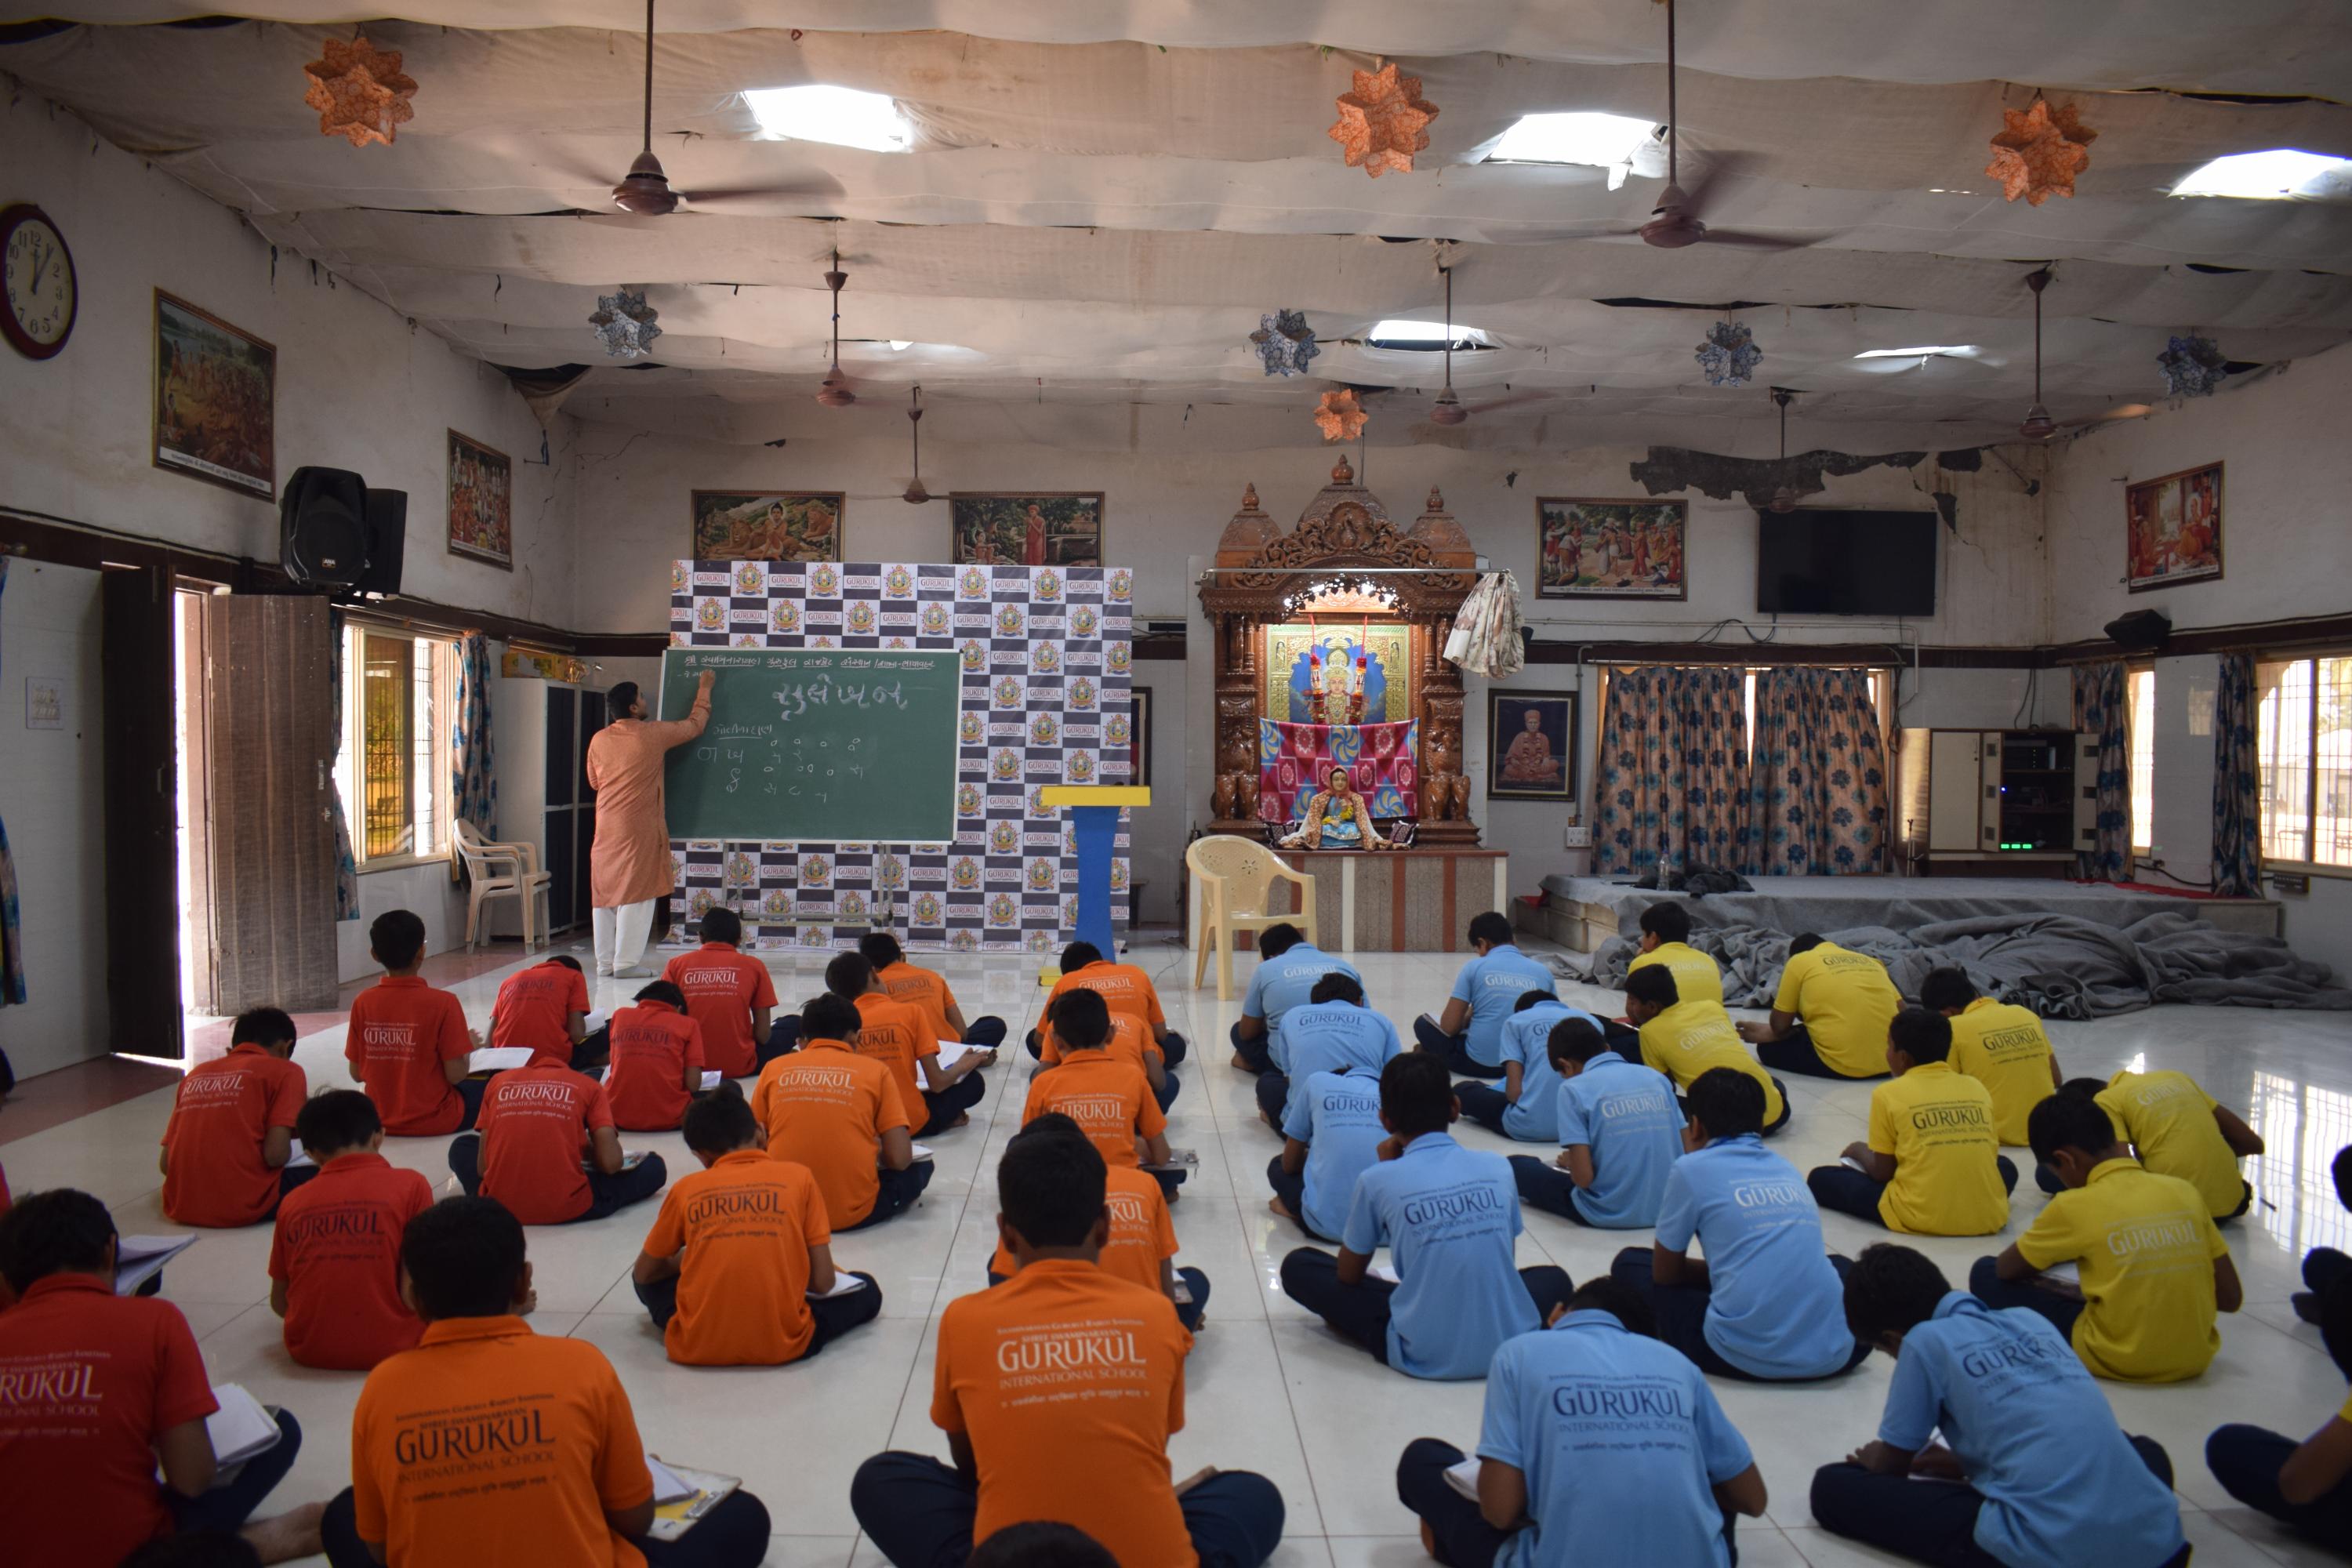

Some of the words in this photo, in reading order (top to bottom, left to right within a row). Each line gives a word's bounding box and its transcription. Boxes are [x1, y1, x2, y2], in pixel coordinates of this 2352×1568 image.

[18, 230, 27, 248] 11
[30, 230, 41, 247] 12
[53, 263, 60, 278] 2
[30, 319, 38, 334] 6
[697, 574, 728, 583] GURUKUL
[771, 575, 802, 584] GURUKUL
[847, 577, 877, 586] GURUKUL
[921, 579, 952, 588] GURUKUL
[995, 580, 1026, 589] GURUKUL
[1069, 581, 1100, 590] GURUKUL
[733, 611, 764, 619] GURUKUL
[808, 612, 839, 621] GURUKUL
[883, 614, 913, 622] GURUKUL
[957, 615, 988, 624] GURUKUL
[1031, 616, 1062, 626] GURUKUL
[1029, 688, 1060, 697] GURUKUL
[1066, 725, 1097, 734] GURUKUL
[1028, 761, 1058, 770] GURUKUL
[1026, 833, 1058, 842] GURUKUL
[690, 865, 720, 874] GURUKUL
[838, 866, 869, 876] GURUKUL
[913, 868, 943, 877] GURUKUL
[988, 869, 1018, 878] GURUKUL
[949, 906, 980, 914] GURUKUL
[1025, 907, 1055, 916] GURUKUL
[684, 972, 739, 984] GURUKUL
[1299, 1014, 1365, 1027] GURUKUL
[365, 1028, 416, 1045] GURUKUL
[1983, 1028, 2042, 1050] GURUKUL
[779, 1072, 855, 1090] GURUKUL
[498, 1086, 575, 1103] GURUKUL
[1602, 1094, 1670, 1118] GURUKUL
[1913, 1108, 1988, 1129] GURUKUL
[688, 1192, 785, 1224] GURUKUL
[1405, 1189, 1504, 1225] GURUKUL
[287, 1212, 385, 1243] GURUKUL
[2107, 1221, 2201, 1255] GURUKUL
[997, 1332, 1146, 1372] GURUKUL
[1000, 1370, 1094, 1390] INTERNATIONAL
[1099, 1368, 1147, 1379] SCHOOL
[1553, 1386, 1690, 1420] GURUKUL
[395, 1409, 556, 1465] GURUKUL
[397, 1459, 495, 1483] INTERNATIONAL
[501, 1450, 555, 1467] SCHOOL
